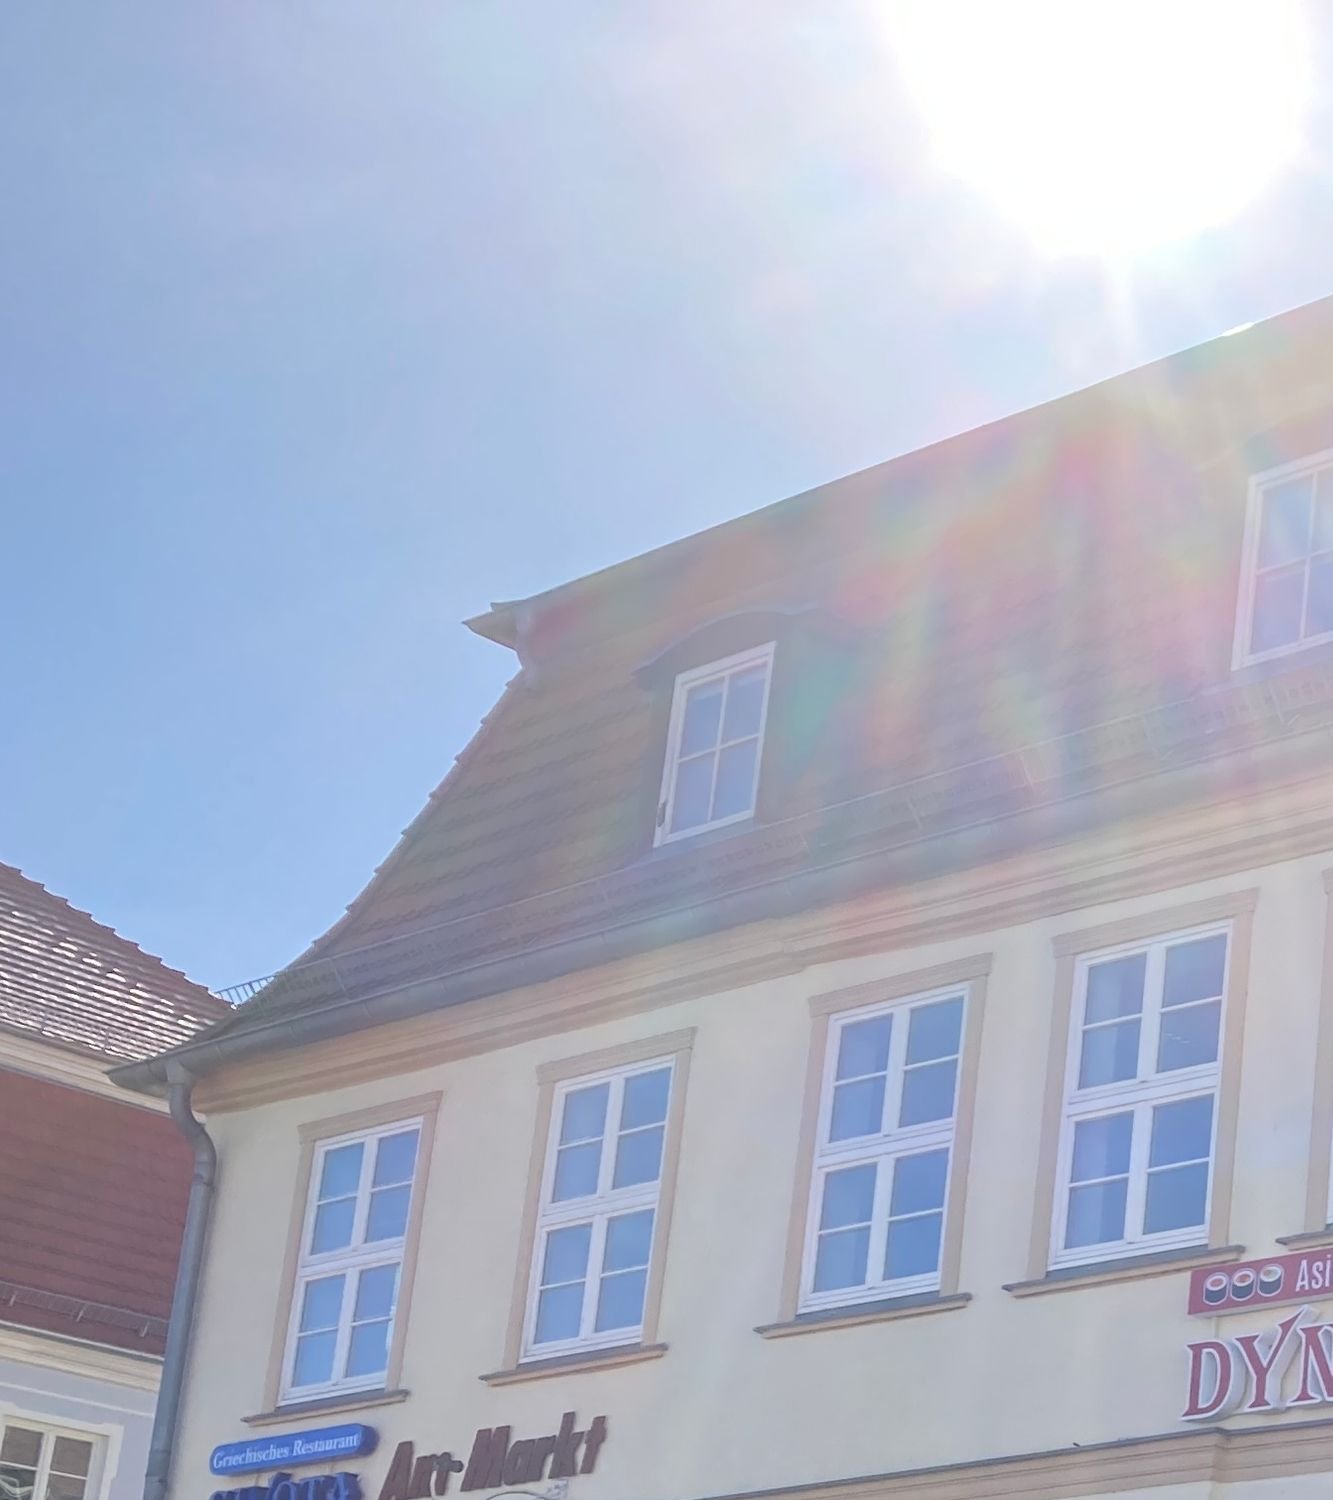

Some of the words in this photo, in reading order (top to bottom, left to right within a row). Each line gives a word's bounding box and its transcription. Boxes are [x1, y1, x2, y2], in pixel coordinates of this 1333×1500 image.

[212, 1444, 290, 1469] Griechisches
[292, 1434, 360, 1457] Restaurant
[459, 1411, 608, 1492] Markt
